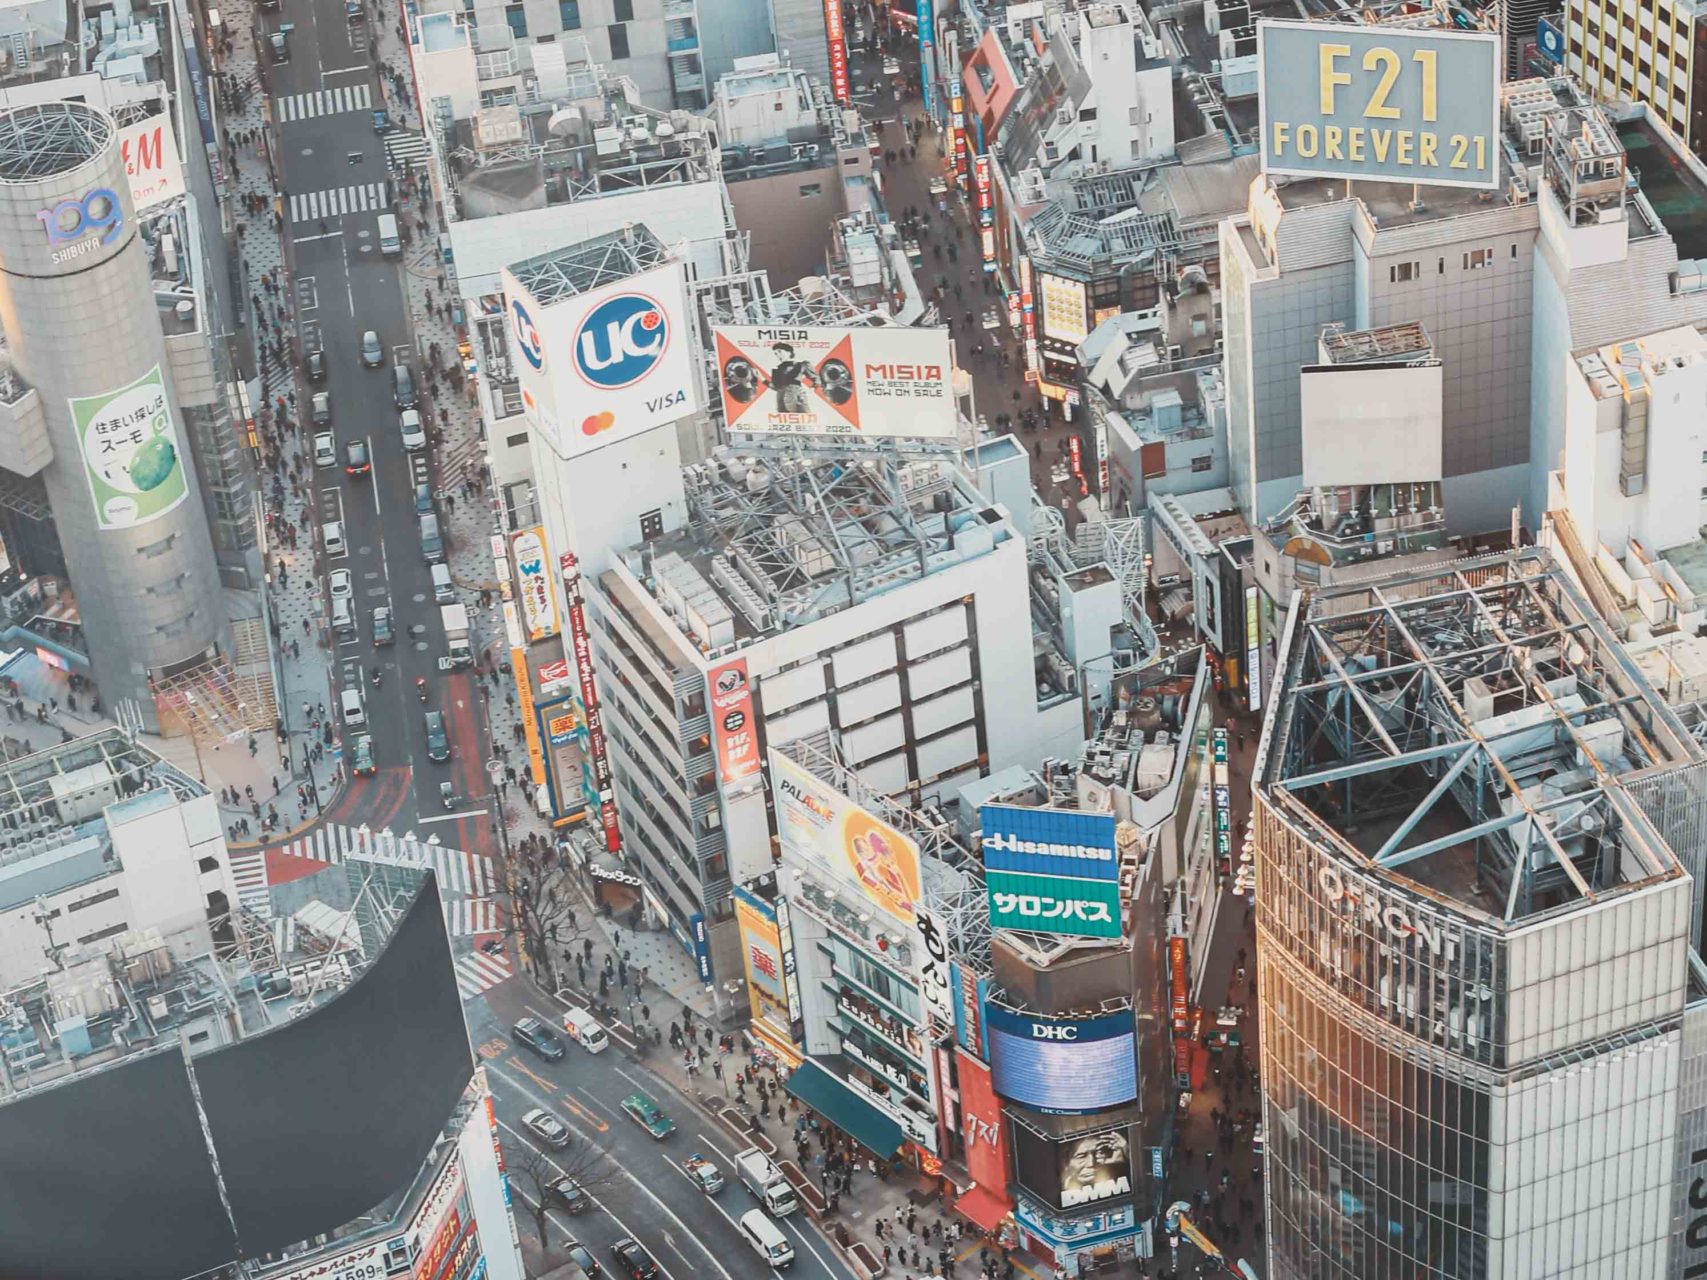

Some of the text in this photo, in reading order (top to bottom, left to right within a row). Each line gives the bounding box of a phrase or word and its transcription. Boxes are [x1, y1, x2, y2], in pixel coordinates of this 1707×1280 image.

[1319, 43, 1438, 122] F21
[1273, 121, 1486, 171] FOREVER 21
[36, 187, 124, 247] 109
[51, 237, 100, 265] SHIBUYA
[580, 308, 662, 371] UC
[758, 329, 809, 341] MISIA
[865, 363, 942, 381] MISIA
[866, 380, 943, 388] NEW BEST ALBUM
[645, 389, 687, 413] VISA
[867, 388, 944, 397] NOW ON SALE
[767, 413, 818, 425] MISIA
[101, 429, 144, 454] スーモ
[982, 832, 1112, 860] Hisamitsu
[993, 892, 1112, 923] サロンパス
[1032, 1023, 1077, 1040] DHC
[1061, 1175, 1131, 1208] DMM
